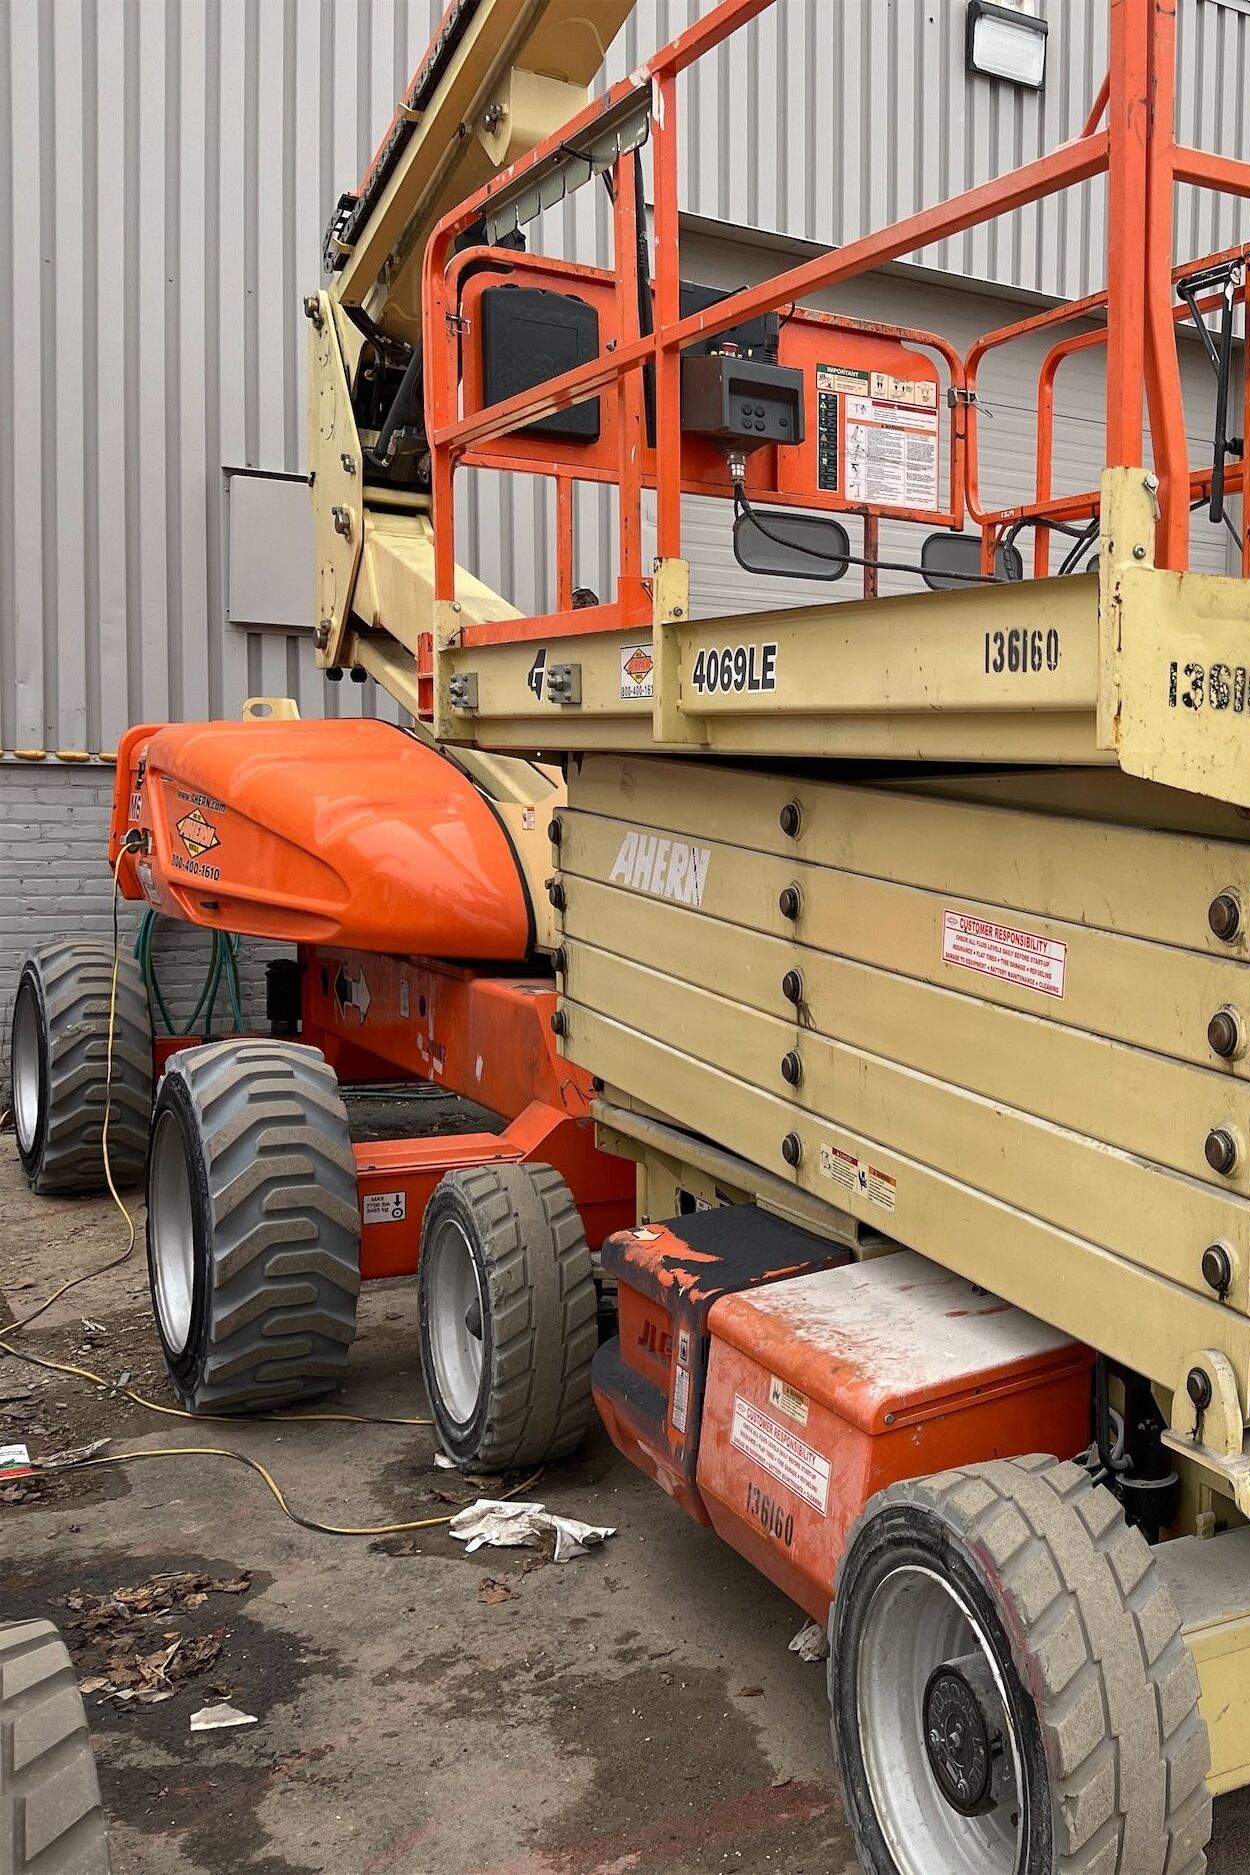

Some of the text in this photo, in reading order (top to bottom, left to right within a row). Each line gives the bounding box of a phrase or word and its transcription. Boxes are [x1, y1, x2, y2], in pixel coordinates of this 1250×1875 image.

[827, 366, 859, 378] IMPORTANT
[985, 628, 1059, 674] 136160
[692, 645, 777, 693] 4069LE
[621, 685, 653, 696] 800-400-161
[178, 790, 226, 812] www.AHERN.com
[172, 854, 220, 880] 800-400-1610
[608, 831, 711, 906] AHERN
[956, 935, 1050, 968] CHECK ALL FLUID LEVELS DAILY BEFORE START-UP
[959, 918, 1048, 953] CUSTOMER RESPONSIBILITY
[945, 952, 960, 962] DAMAGE
[966, 958, 987, 970] EQUIPMENT
[990, 965, 1007, 976] BATTERY
[1008, 971, 1035, 986] MAINTENANCE
[1038, 981, 1060, 993] CLEANING
[976, 951, 985, 959] FLAT
[986, 954, 997, 962] TIRES
[1000, 958, 1009, 967] TIRE
[1010, 961, 1026, 972] DAMAGE
[1029, 967, 1052, 980] REFUELING
[746, 1407, 816, 1466] CUSTOMER RESPONSIBILITY
[746, 1482, 794, 1548] 136160
